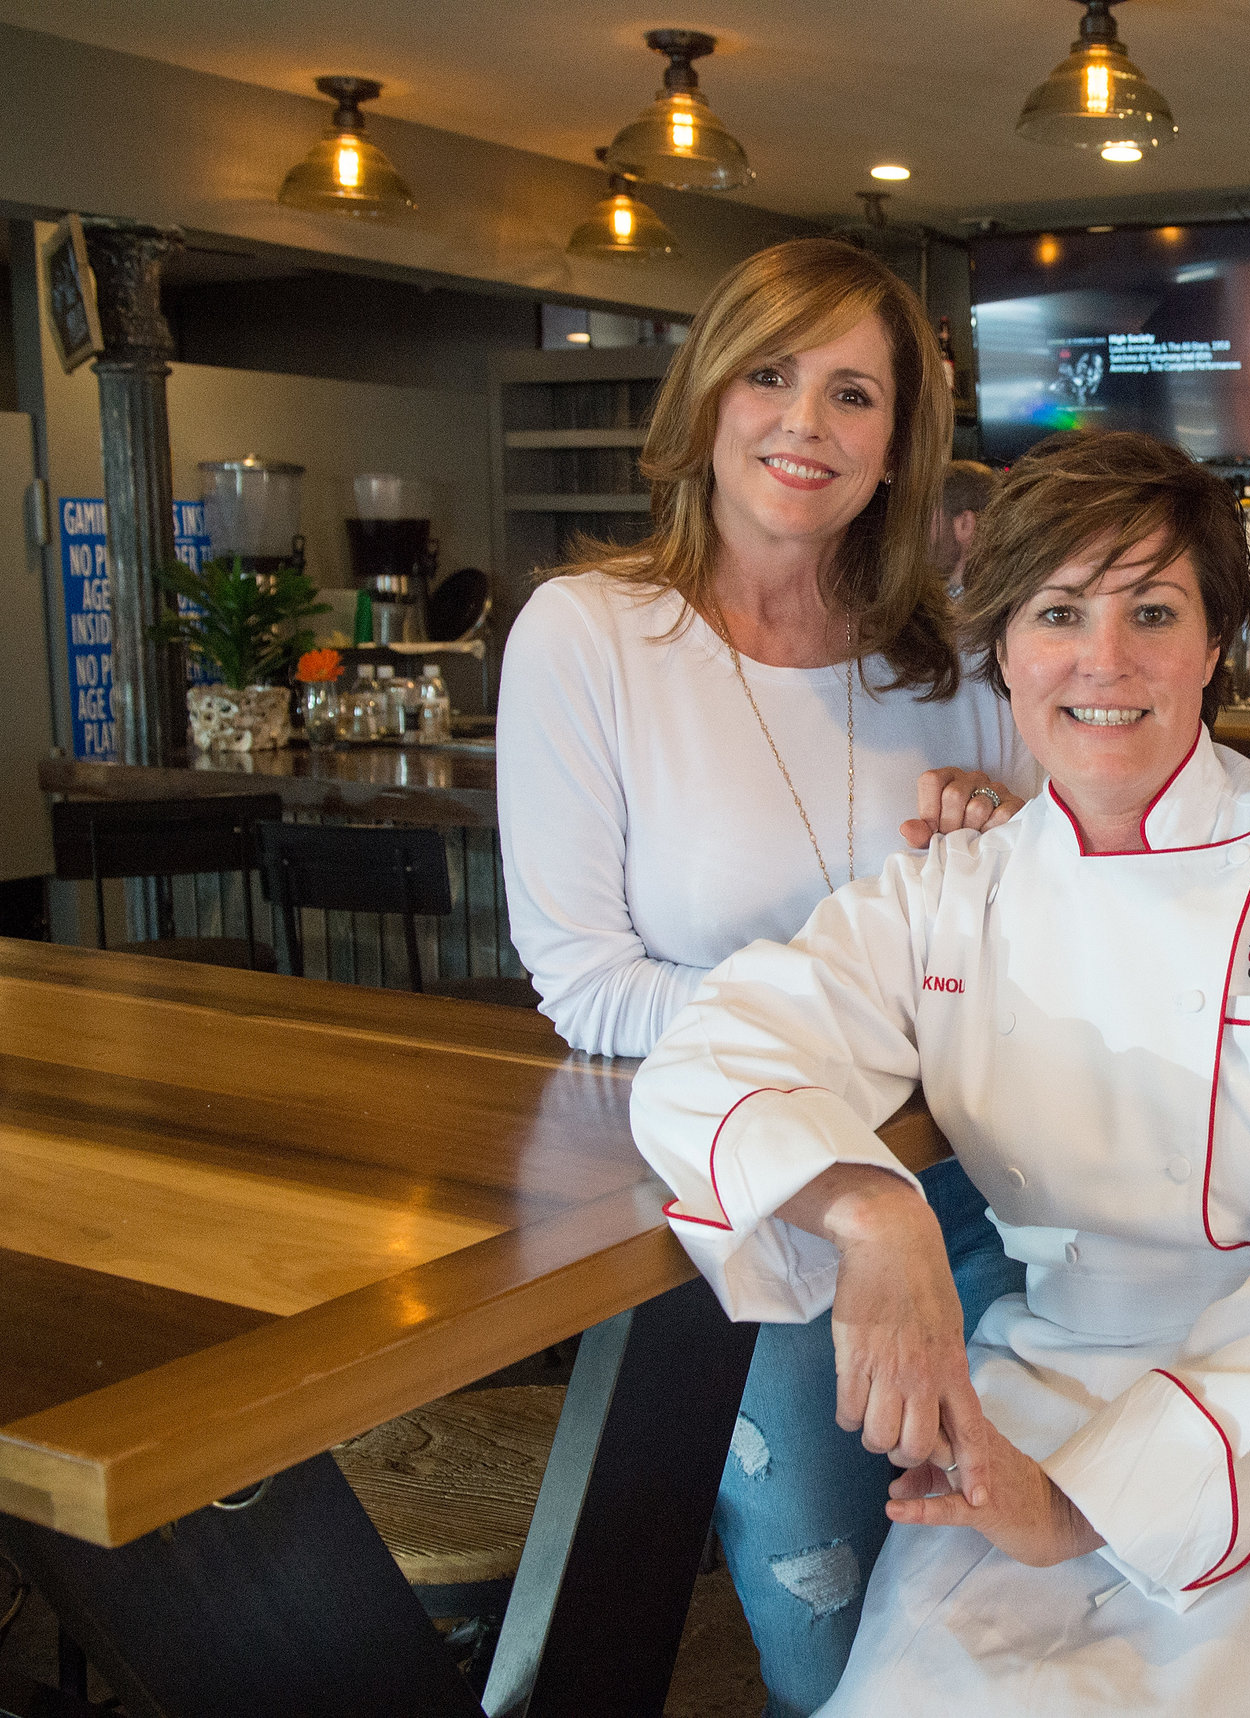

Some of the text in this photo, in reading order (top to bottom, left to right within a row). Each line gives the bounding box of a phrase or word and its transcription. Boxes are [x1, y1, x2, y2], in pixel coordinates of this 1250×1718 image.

[69, 543, 92, 577] NO
[83, 577, 111, 611] AGE
[71, 613, 112, 646] INSID
[75, 653, 98, 687] NO
[78, 687, 107, 721] AGE
